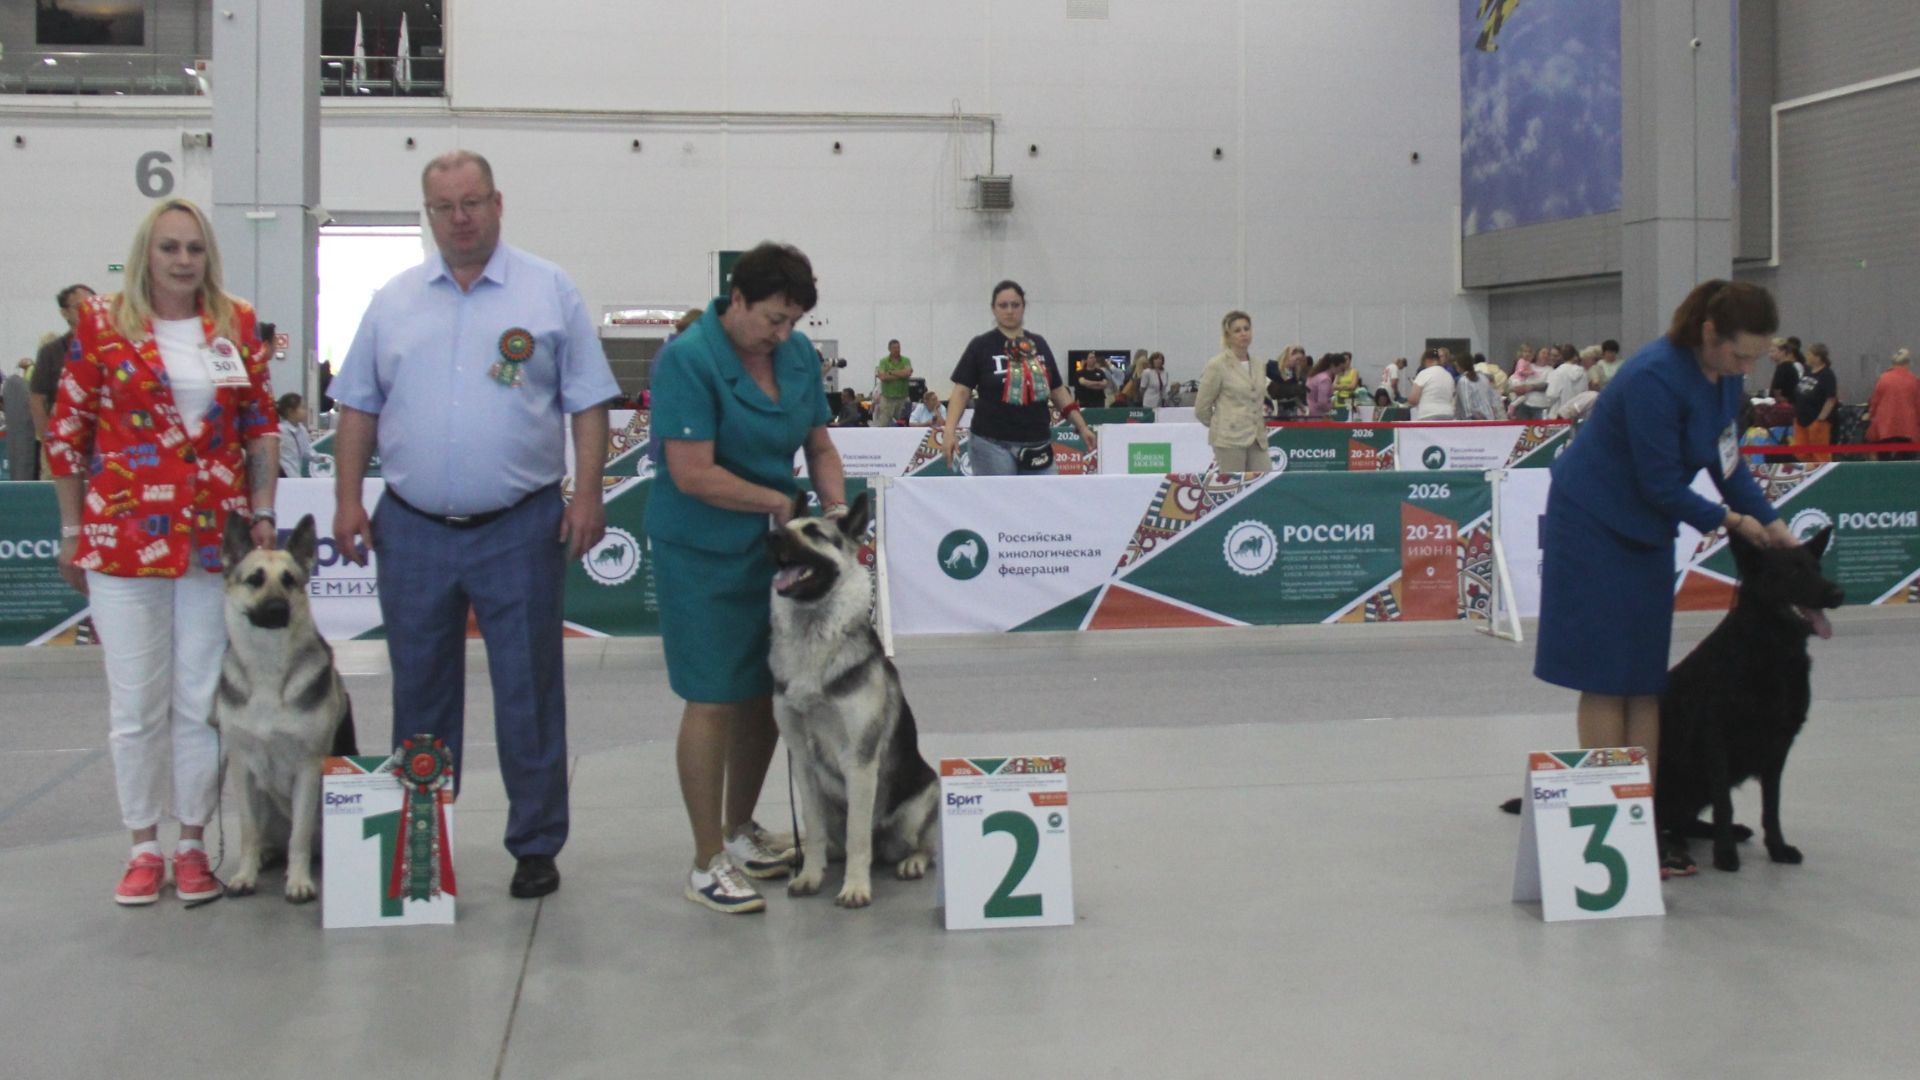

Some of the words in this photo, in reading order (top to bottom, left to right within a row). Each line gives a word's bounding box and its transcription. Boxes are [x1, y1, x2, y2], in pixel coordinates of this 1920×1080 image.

[136, 150, 175, 198] 6
[1352, 429, 1374, 437] 2026
[1056, 453, 1081, 461] 20-21
[1290, 449, 1336, 458] РОССИЯ
[1350, 450, 1375, 458] 20-21
[1408, 484, 1451, 499] 2026
[1839, 511, 1917, 529] РОССИЯ
[998, 532, 1072, 543] Российская
[1283, 523, 1375, 543] РОССИЯ
[1406, 524, 1453, 540] 20-21
[998, 548, 1102, 559] кинологическая
[1408, 545, 1453, 556] ИЮНЯ
[998, 564, 1070, 577] федерация
[310, 581, 378, 595] ЕМИУ
[325, 791, 363, 807] Брит
[946, 793, 983, 808] Брит
[1533, 787, 1568, 802] Брит
[362, 809, 404, 918] 1
[982, 810, 1043, 919] 2
[1569, 804, 1629, 912] 3
